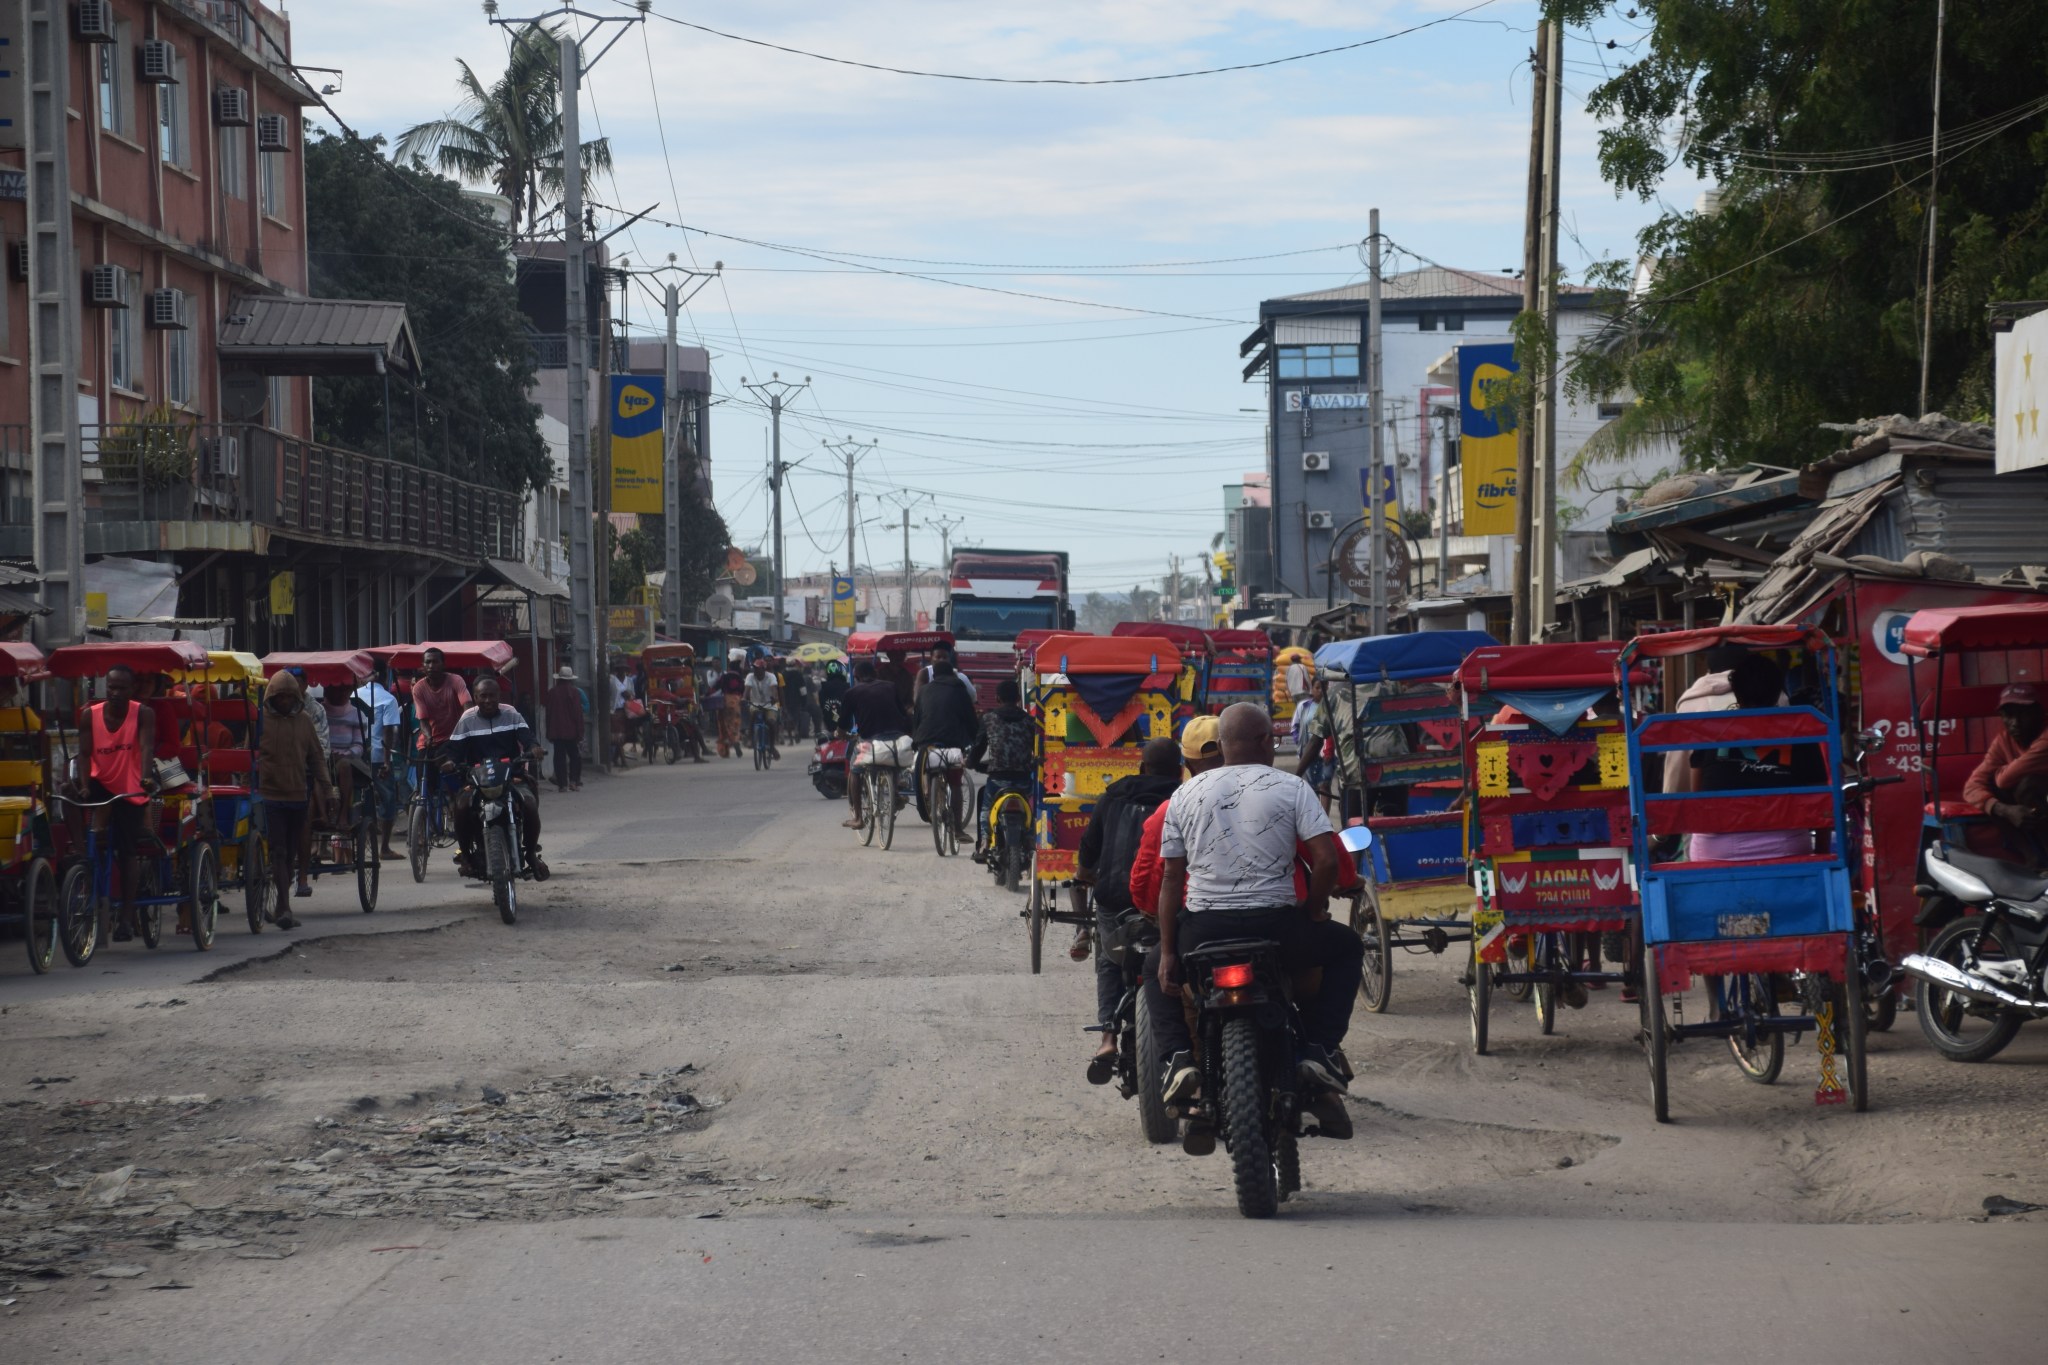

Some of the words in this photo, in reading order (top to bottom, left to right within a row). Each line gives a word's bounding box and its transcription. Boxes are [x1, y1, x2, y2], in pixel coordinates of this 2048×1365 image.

[624, 395, 650, 410] yas
[1302, 386, 1312, 437] HOTEL
[1477, 483, 1517, 498] fibre
[1530, 868, 1591, 888] JAONA
